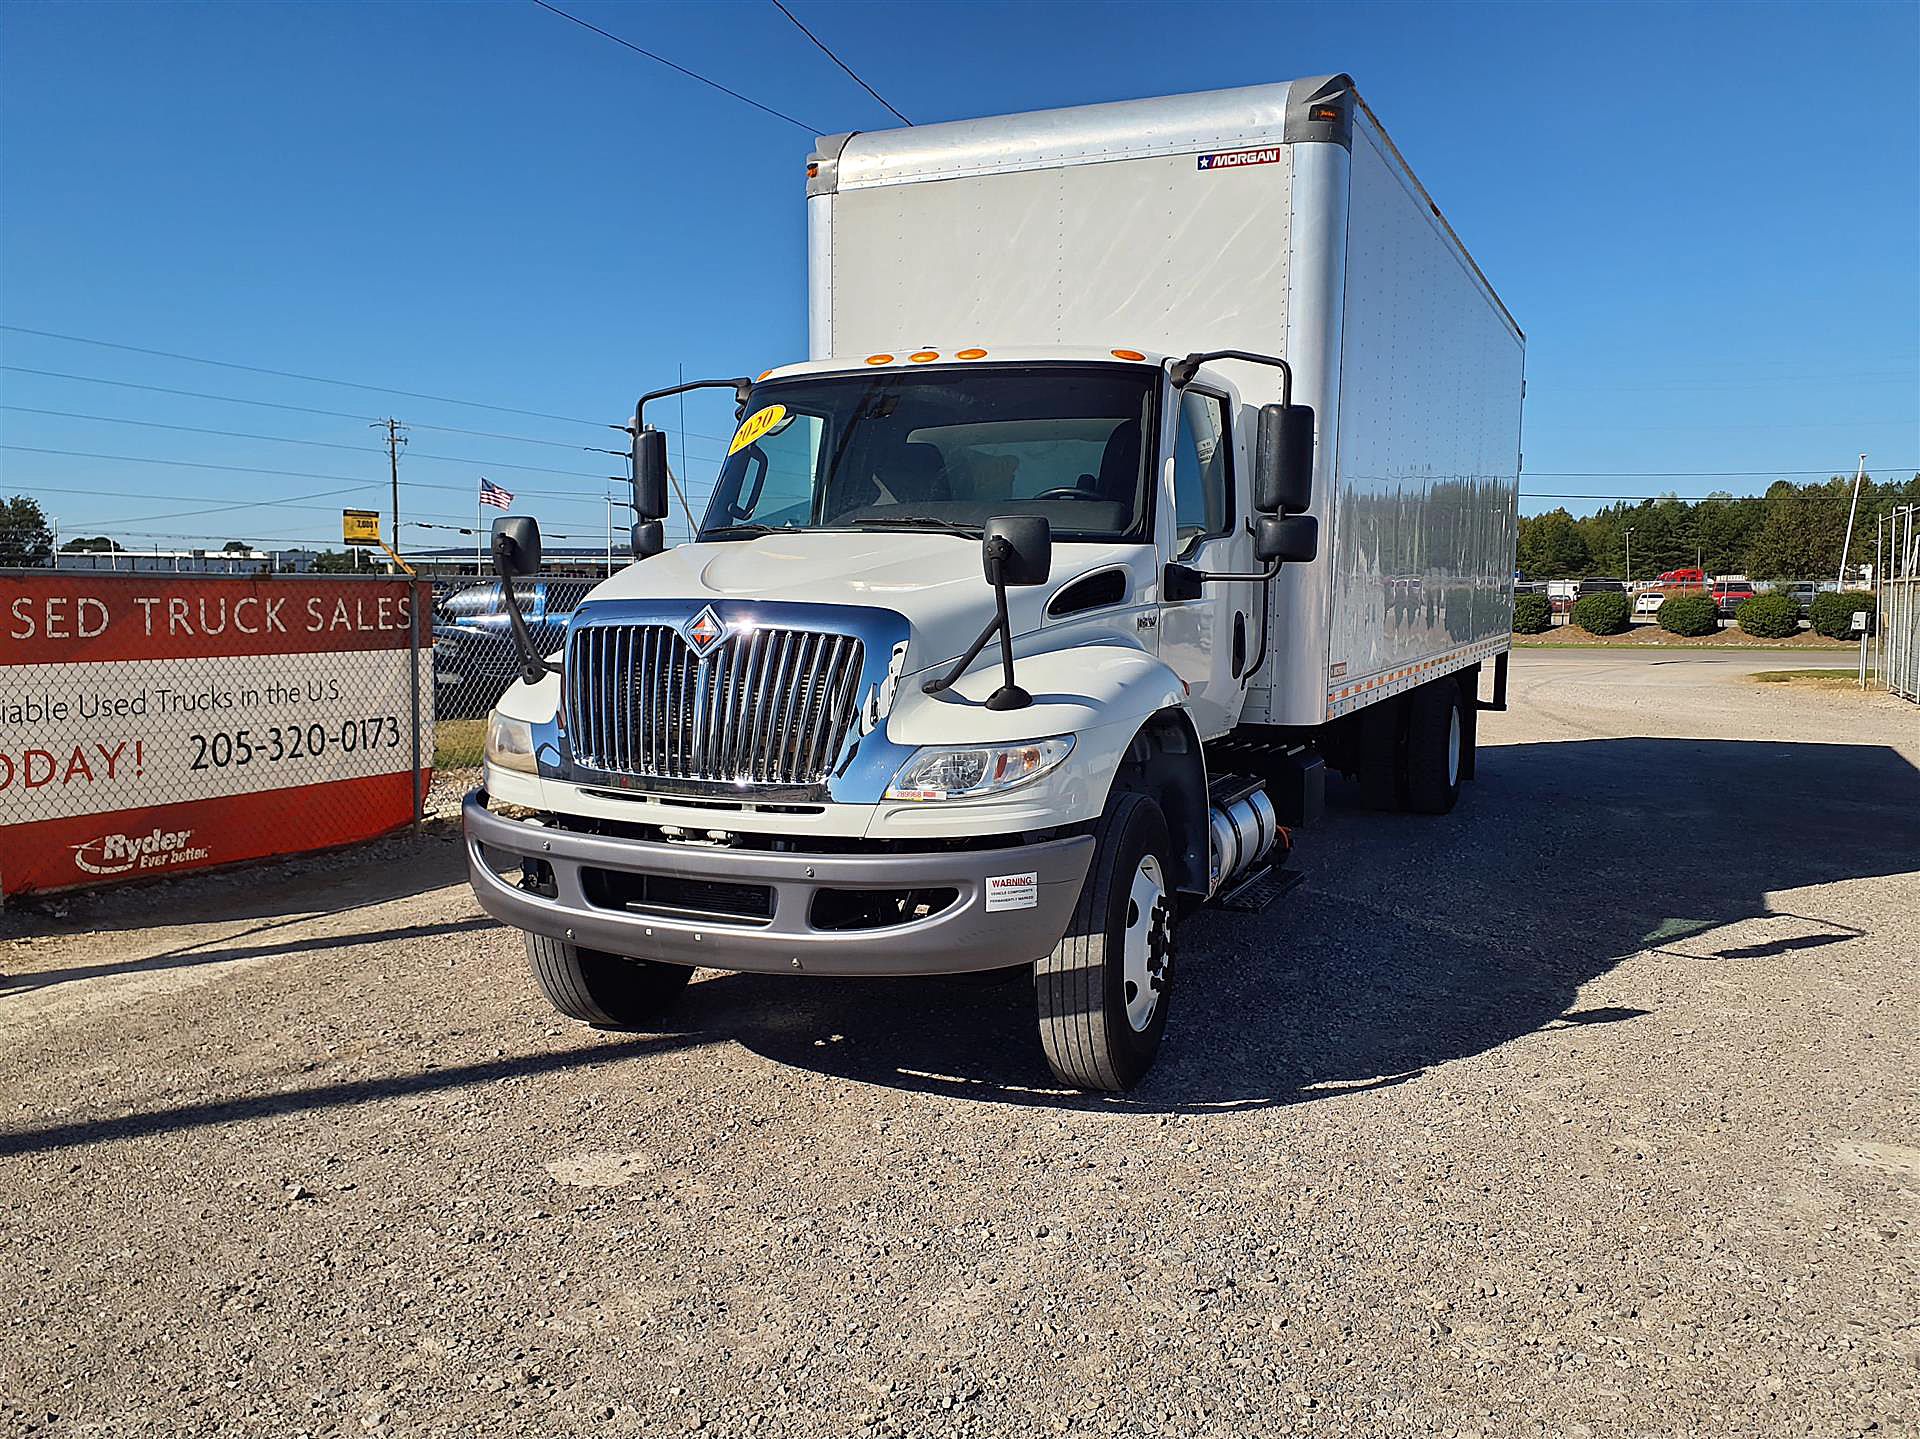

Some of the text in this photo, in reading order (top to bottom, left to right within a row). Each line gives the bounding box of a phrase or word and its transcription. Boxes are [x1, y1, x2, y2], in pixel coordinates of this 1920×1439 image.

[1212, 151, 1279, 167] MORGAN
[733, 409, 774, 450] 2020
[10, 596, 411, 639] SED TRUCK SALES
[79, 688, 147, 719] Used
[157, 681, 233, 712] Trucks
[240, 684, 259, 707] in
[266, 680, 301, 705] the
[308, 678, 345, 703] U.S.
[189, 716, 401, 771] 205-320-0173
[103, 828, 192, 862] Ryder
[139, 847, 209, 869] Ever better.
[991, 877, 1033, 888] WARNING
